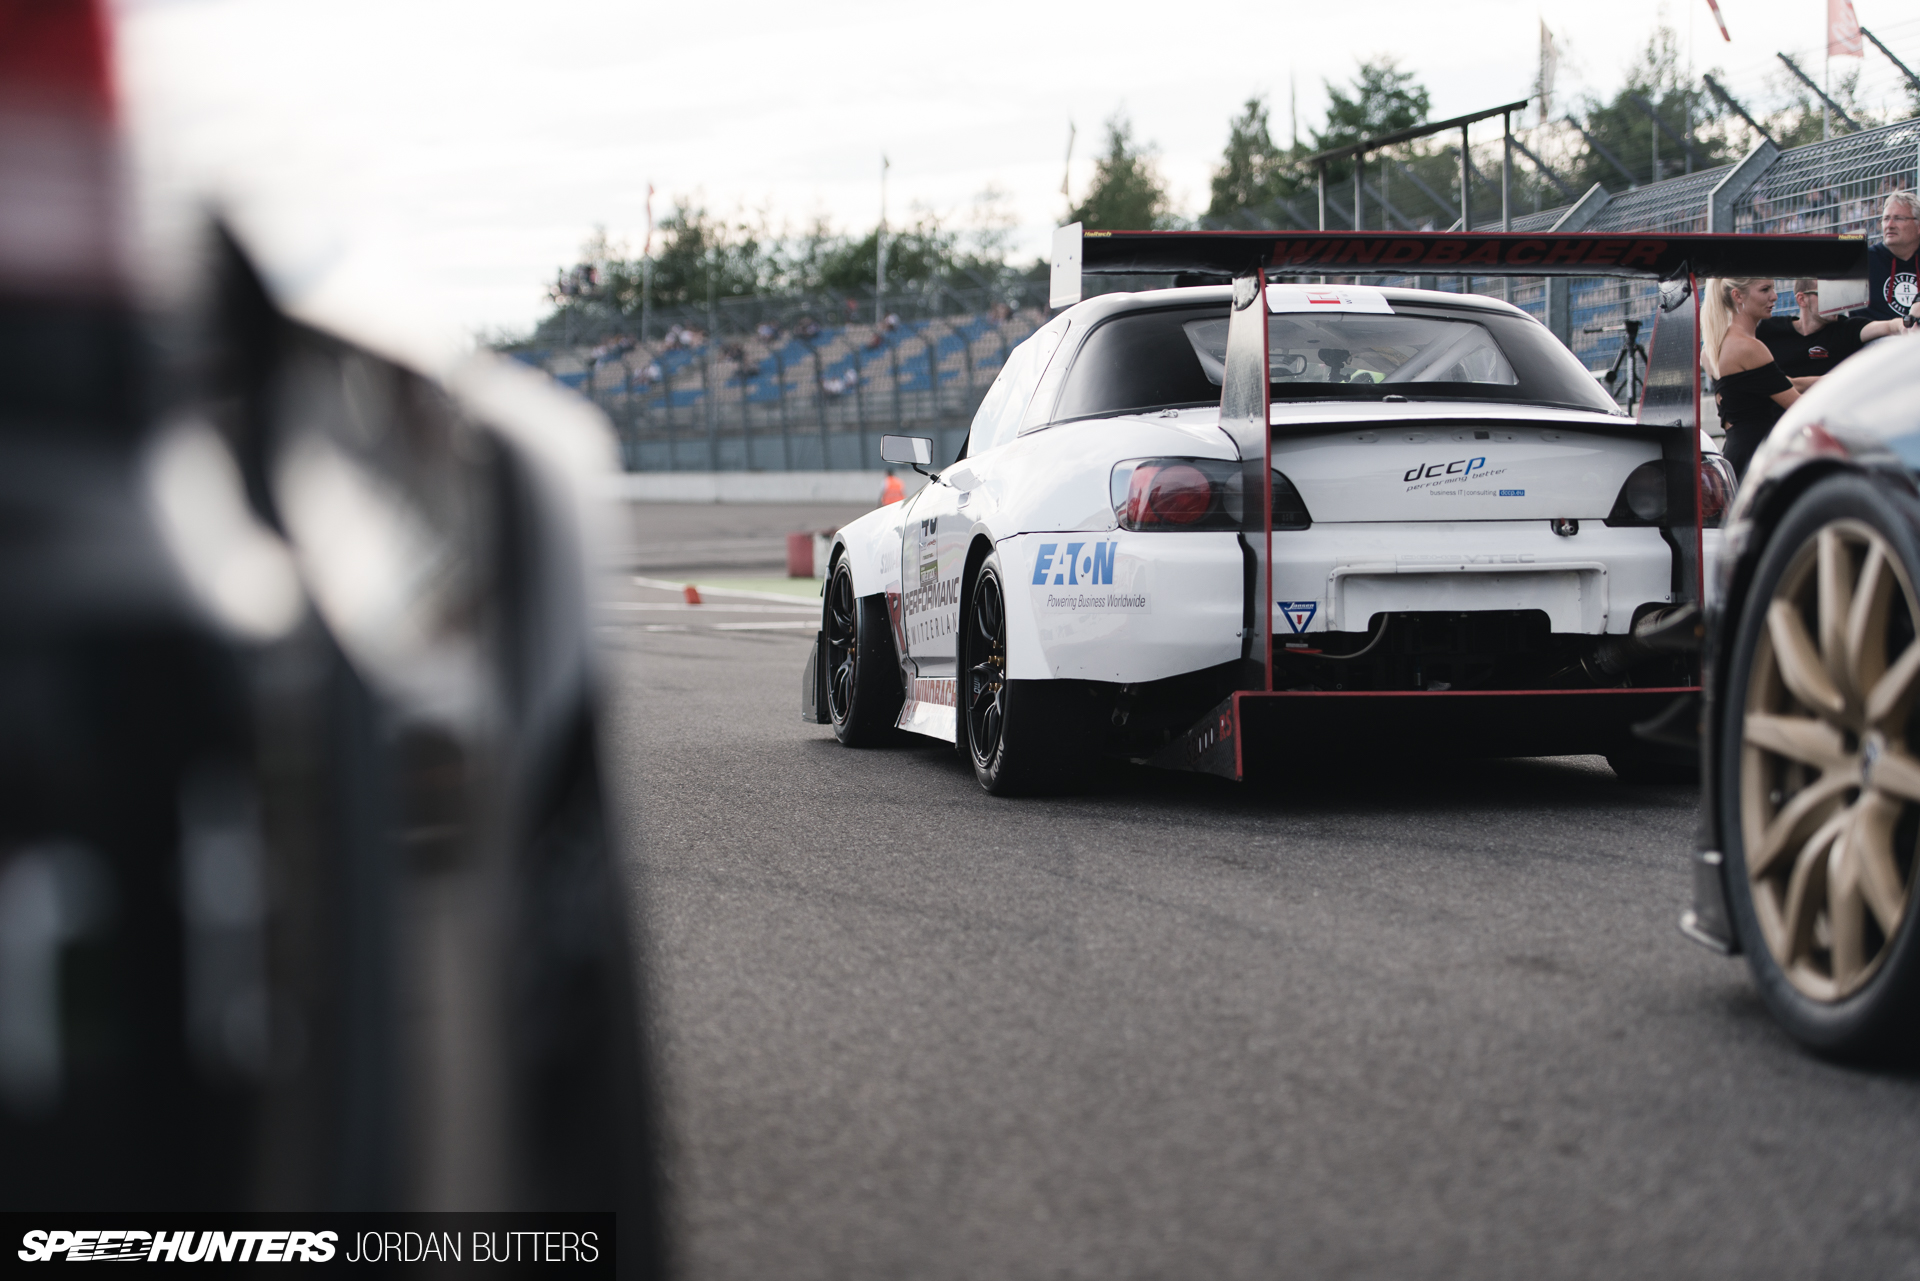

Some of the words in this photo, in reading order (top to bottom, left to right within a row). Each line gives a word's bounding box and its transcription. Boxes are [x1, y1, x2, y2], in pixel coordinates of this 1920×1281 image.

[1272, 239, 1669, 266] WINDBACHER
[1403, 457, 1486, 482] dccp
[1406, 475, 1468, 493] performing
[1472, 468, 1508, 479] better
[1032, 541, 1118, 585] EATON
[1463, 553, 1536, 564] VTEC
[1046, 594, 1078, 610] Powering
[1078, 594, 1106, 608] Business
[1107, 594, 1146, 608] Worldwide
